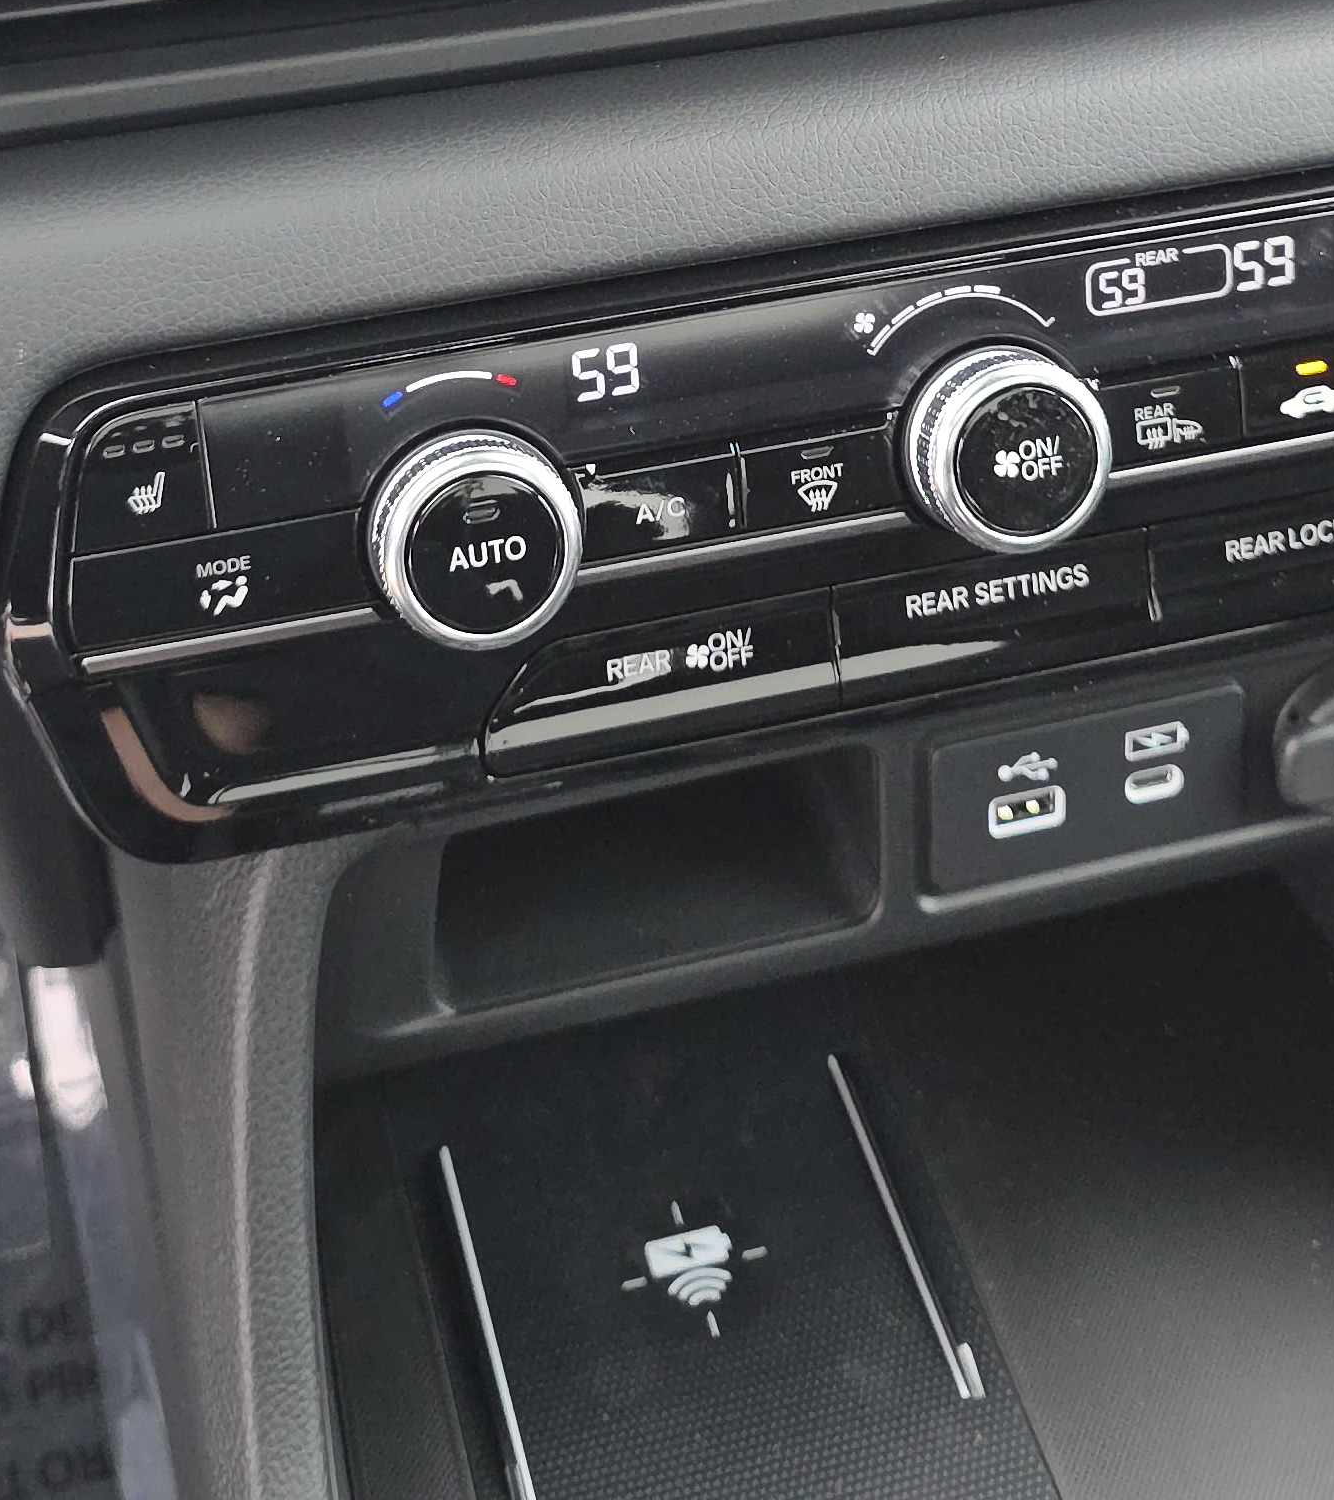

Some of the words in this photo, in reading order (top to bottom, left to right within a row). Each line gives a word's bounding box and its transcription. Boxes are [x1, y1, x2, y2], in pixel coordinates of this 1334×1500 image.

[1134, 247, 1179, 269] REAR
[1233, 235, 1296, 292] 59
[1097, 267, 1147, 309] 59
[571, 342, 640, 403] 59
[1133, 402, 1176, 422] REAR
[1018, 435, 1062, 461] ON/
[790, 462, 844, 485] FRONT
[1019, 456, 1064, 482] OFF
[635, 496, 687, 525] A/C
[448, 535, 527, 573] AUTO
[1224, 530, 1286, 563] REAR
[195, 554, 252, 580] MODE
[905, 585, 970, 619] REAR
[974, 563, 1090, 606] SETTINGS
[707, 626, 753, 652] ON/
[606, 649, 673, 682] REAR
[708, 645, 754, 672] OFF
